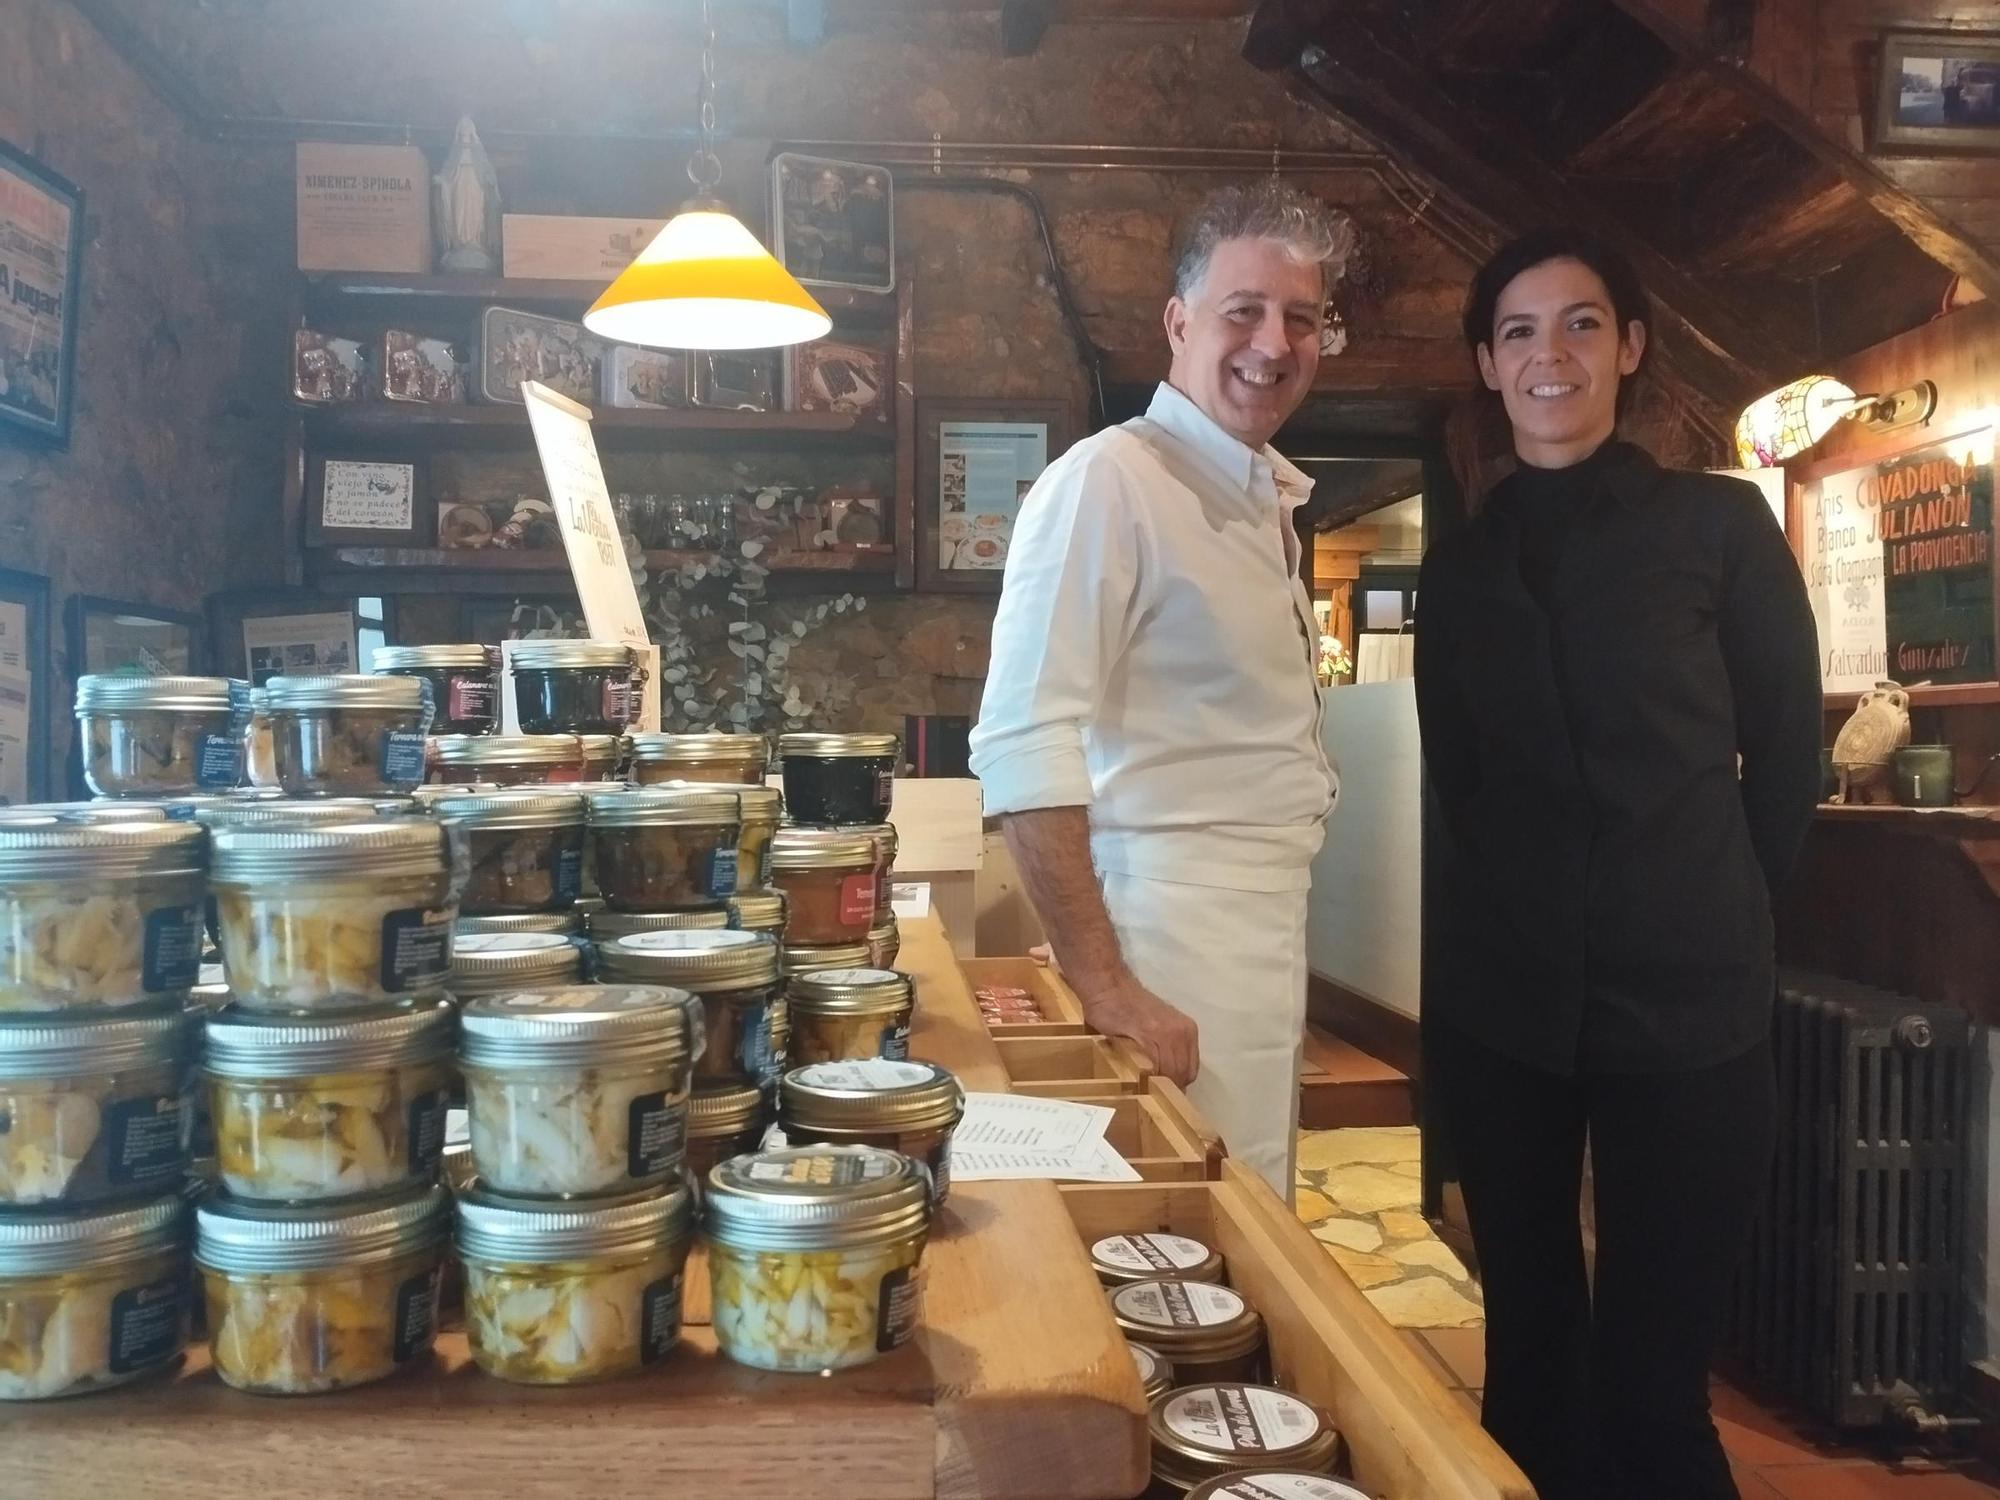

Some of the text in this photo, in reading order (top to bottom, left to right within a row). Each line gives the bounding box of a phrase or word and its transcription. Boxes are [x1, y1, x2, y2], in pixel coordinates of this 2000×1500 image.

[1856, 452, 1978, 510] COVADONGA
[1817, 526, 1856, 554] Blanco
[1892, 530, 1987, 576] LA PROVIDENCIA
[1826, 644, 1889, 677] Salvador
